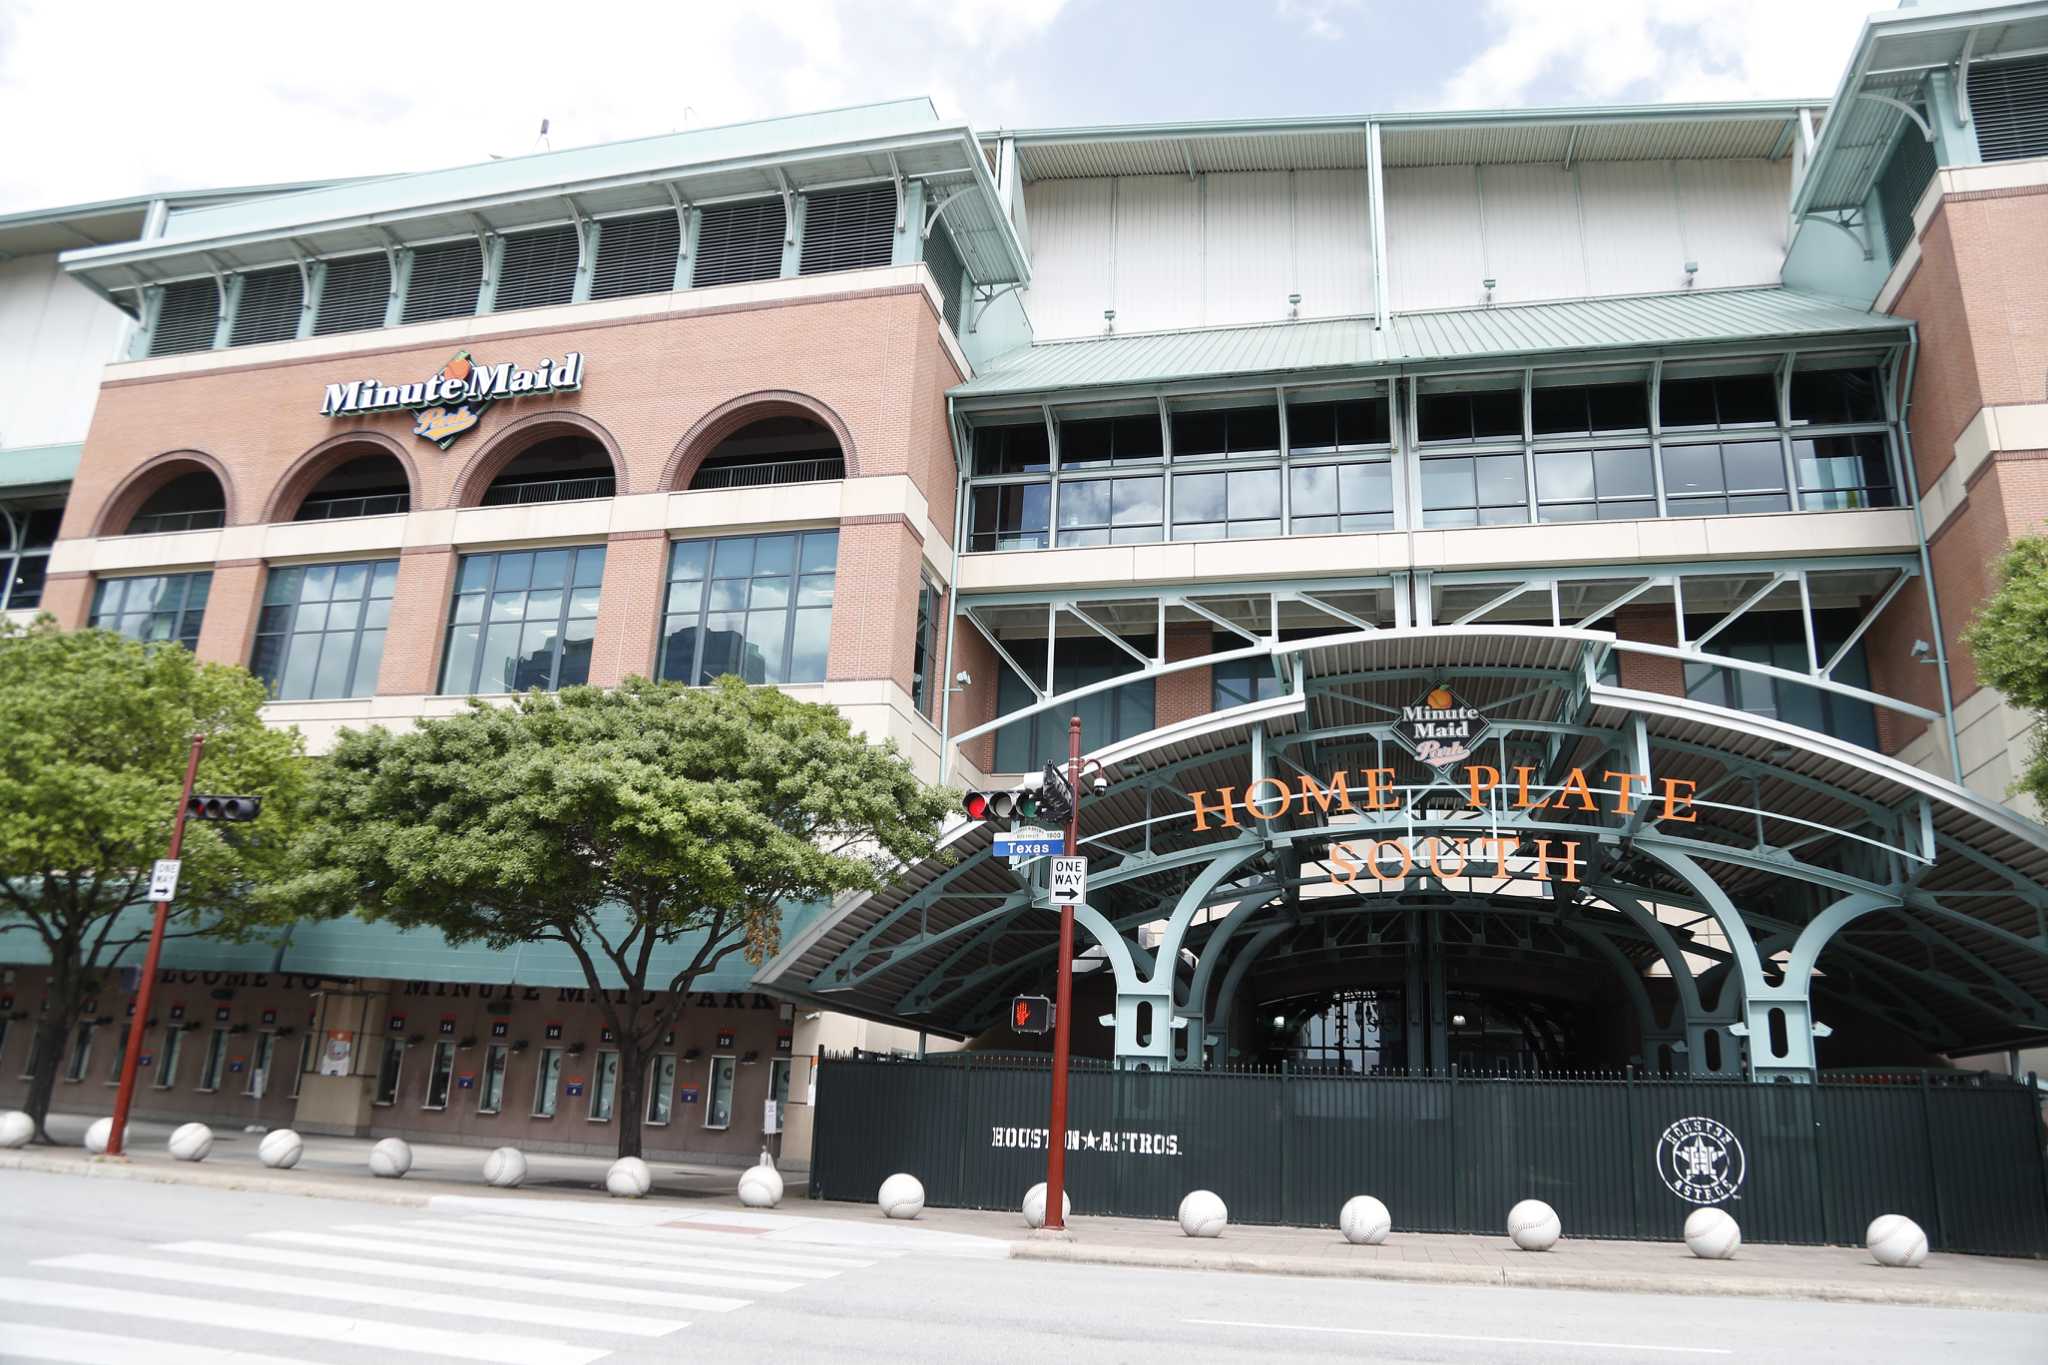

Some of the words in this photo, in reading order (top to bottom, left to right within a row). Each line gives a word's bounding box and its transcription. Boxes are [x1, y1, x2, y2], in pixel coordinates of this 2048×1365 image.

[319, 374, 467, 415] Minute
[466, 352, 583, 397] Maid
[414, 406, 479, 441] Park
[1402, 705, 1480, 721] Minute
[1413, 721, 1470, 738] Maid
[1414, 740, 1471, 767] Park
[1187, 767, 1399, 832] HOME
[1464, 765, 1698, 823] PLATE
[1008, 842, 1049, 854] Texas
[1055, 861, 1082, 872] ONE
[1330, 837, 1581, 886] SOUTH
[1055, 874, 1082, 885] WAY
[992, 1127, 1080, 1150] HOUSTN
[1674, 1179, 1734, 1200] ASTROS
